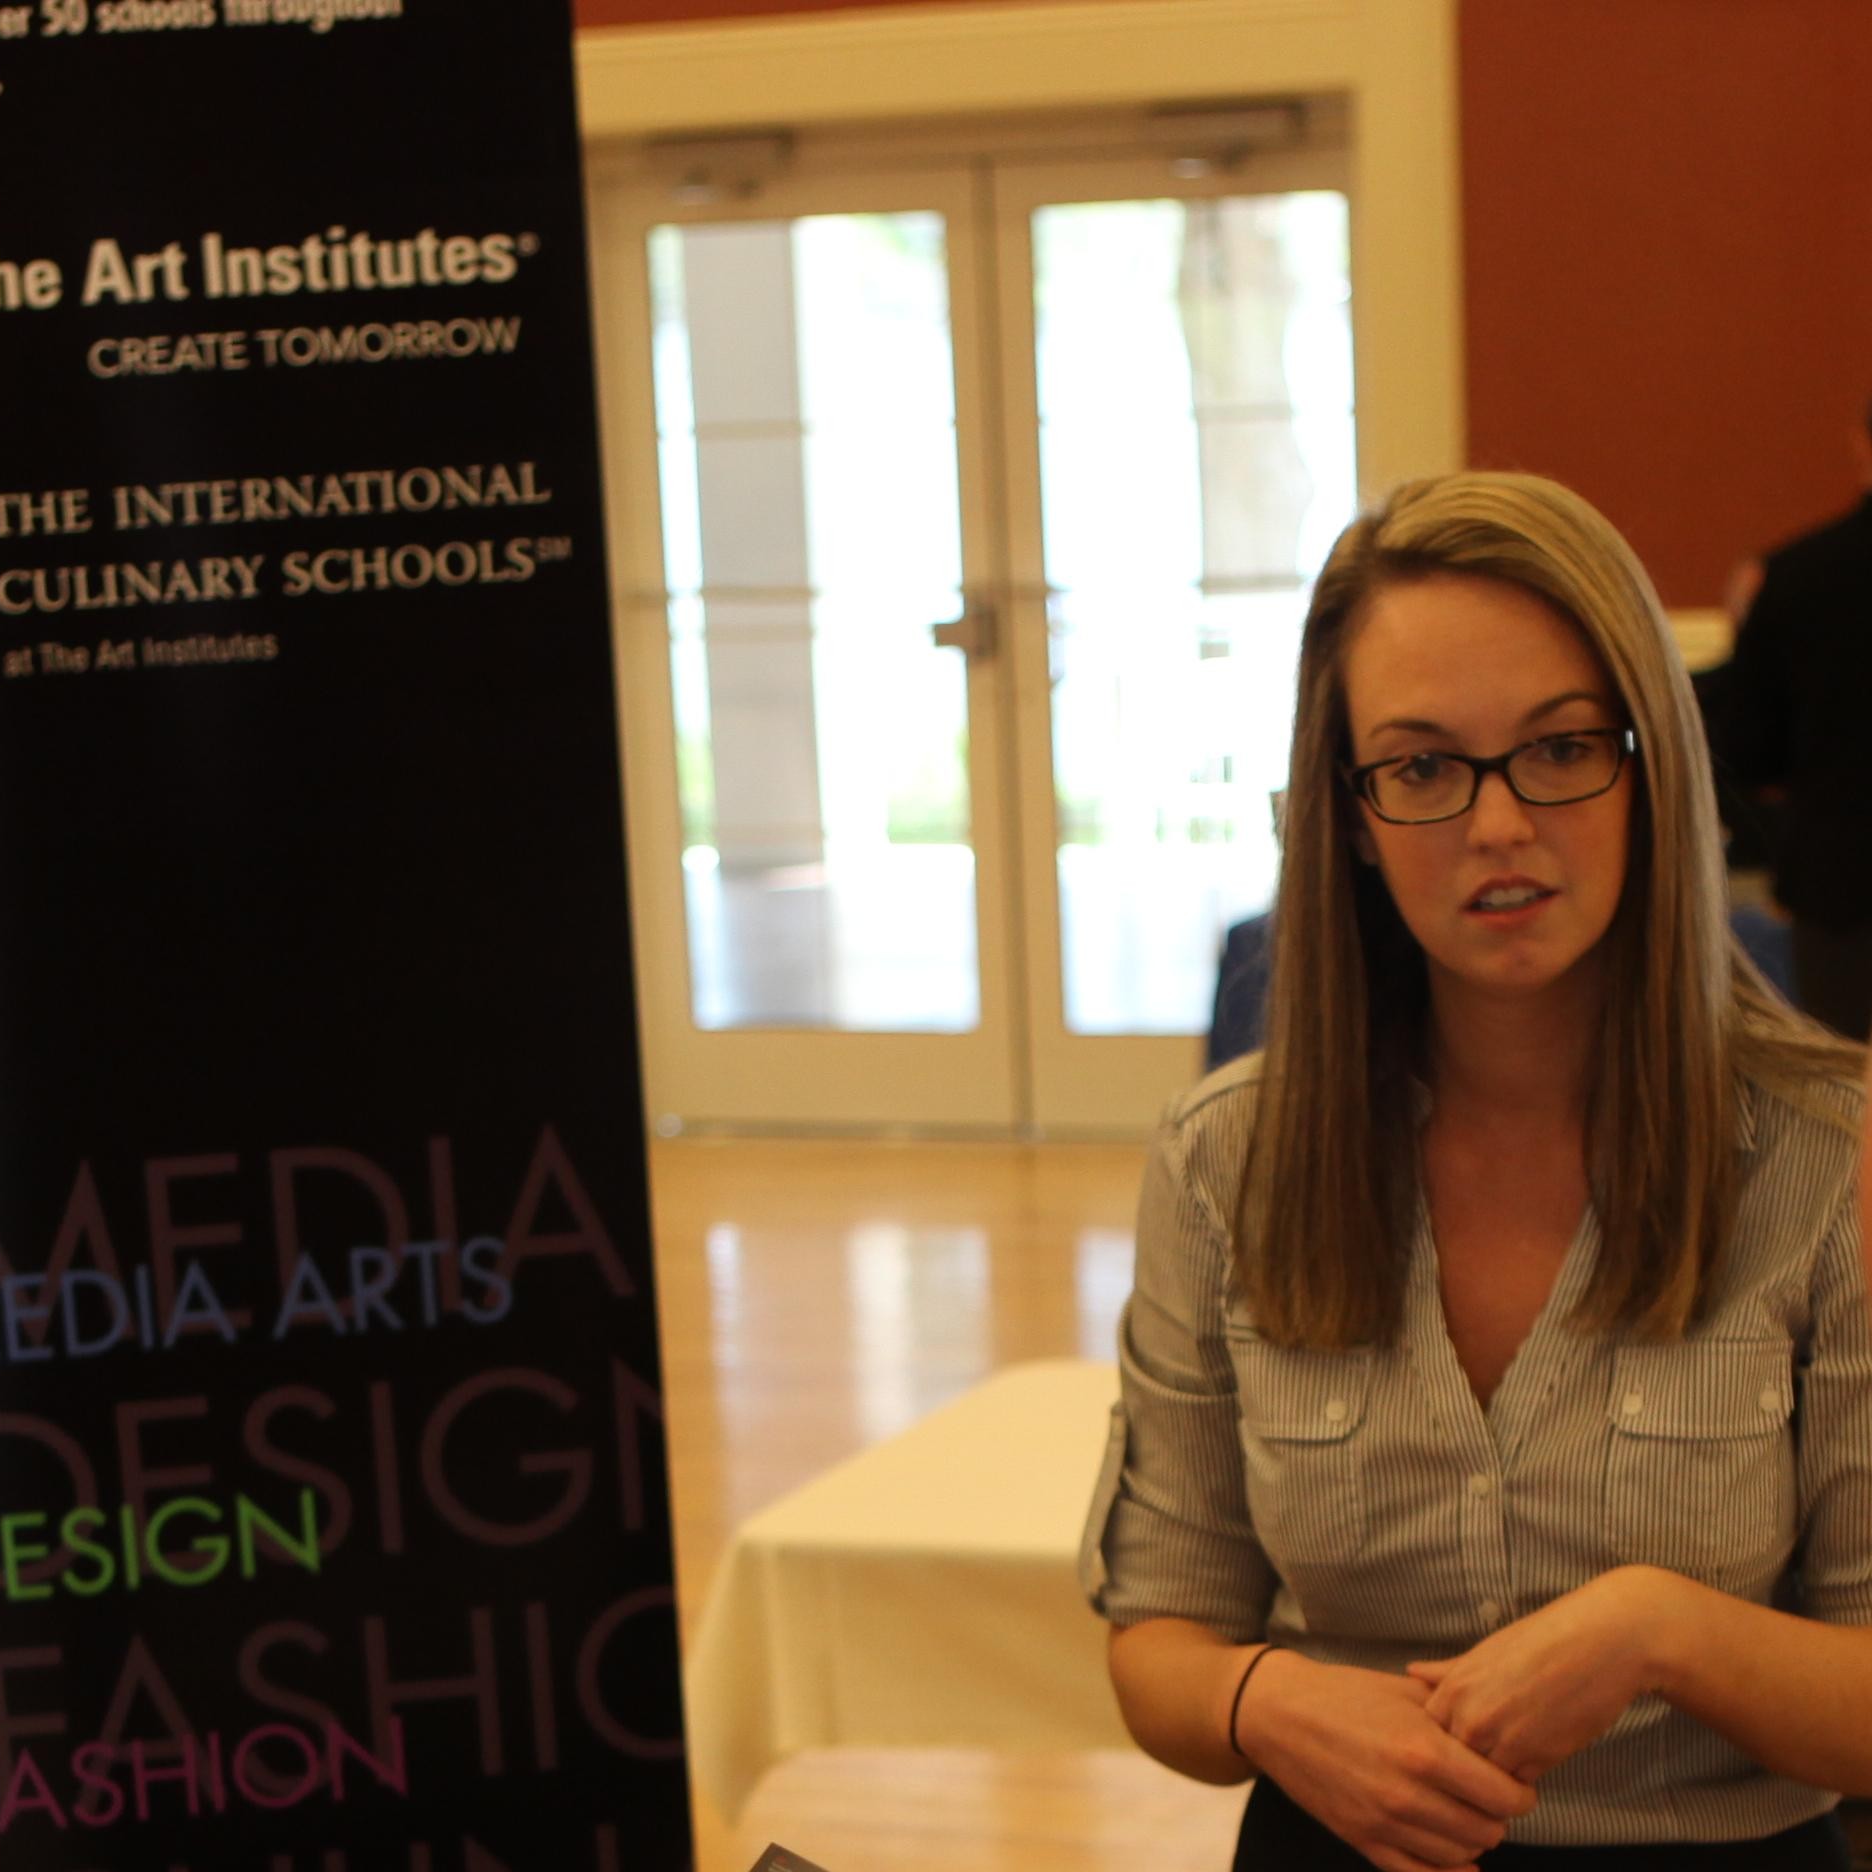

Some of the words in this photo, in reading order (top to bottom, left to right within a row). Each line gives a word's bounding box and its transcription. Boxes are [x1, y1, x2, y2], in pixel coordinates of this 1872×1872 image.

[40, 0, 89, 37] 50
[82, 236, 188, 307] Art
[88, 324, 249, 379] CREATE
[260, 315, 521, 369] TOMORROW
[113, 462, 551, 531] INTERNATIONAL
[40, 641, 90, 673] The
[95, 638, 136, 670] Art
[142, 632, 279, 666] Institutes
[273, 1235, 514, 1342] ARTS
